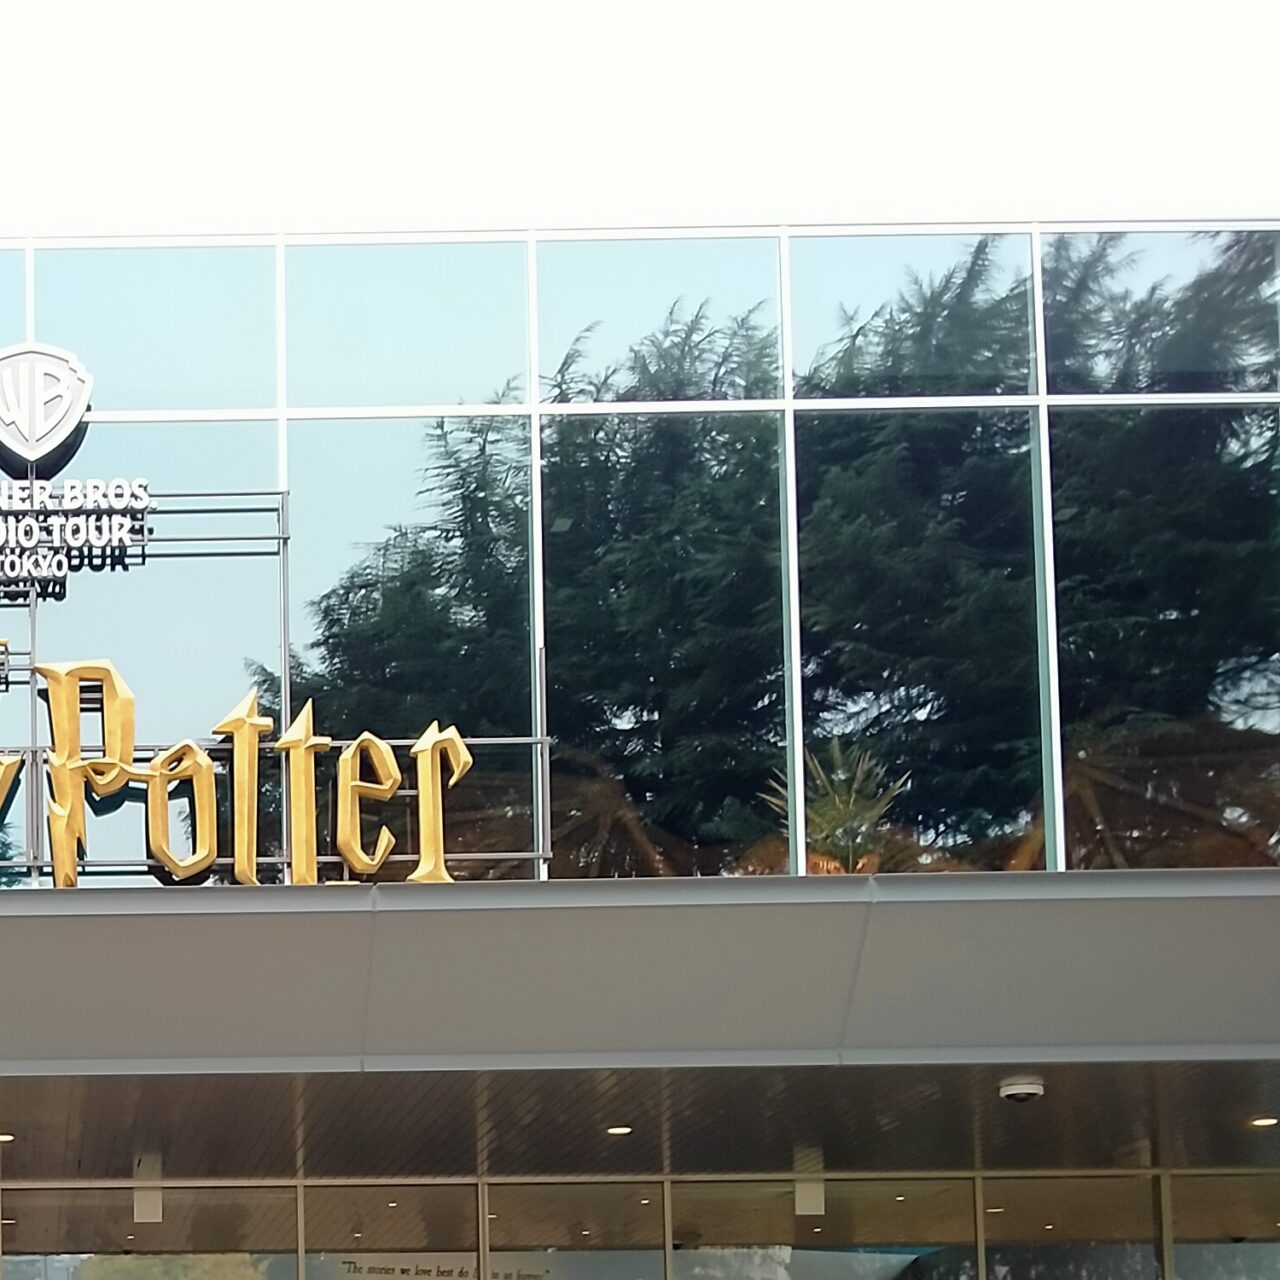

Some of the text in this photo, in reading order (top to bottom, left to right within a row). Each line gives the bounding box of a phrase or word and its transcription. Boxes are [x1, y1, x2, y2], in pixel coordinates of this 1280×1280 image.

[62, 478, 158, 511] BROS.
[48, 514, 133, 548] TOUR
[34, 658, 474, 888] Potter
[400, 1267, 411, 1276] we
[414, 1264, 432, 1277] love
[435, 1265, 454, 1278] best
[457, 1266, 469, 1278] do
